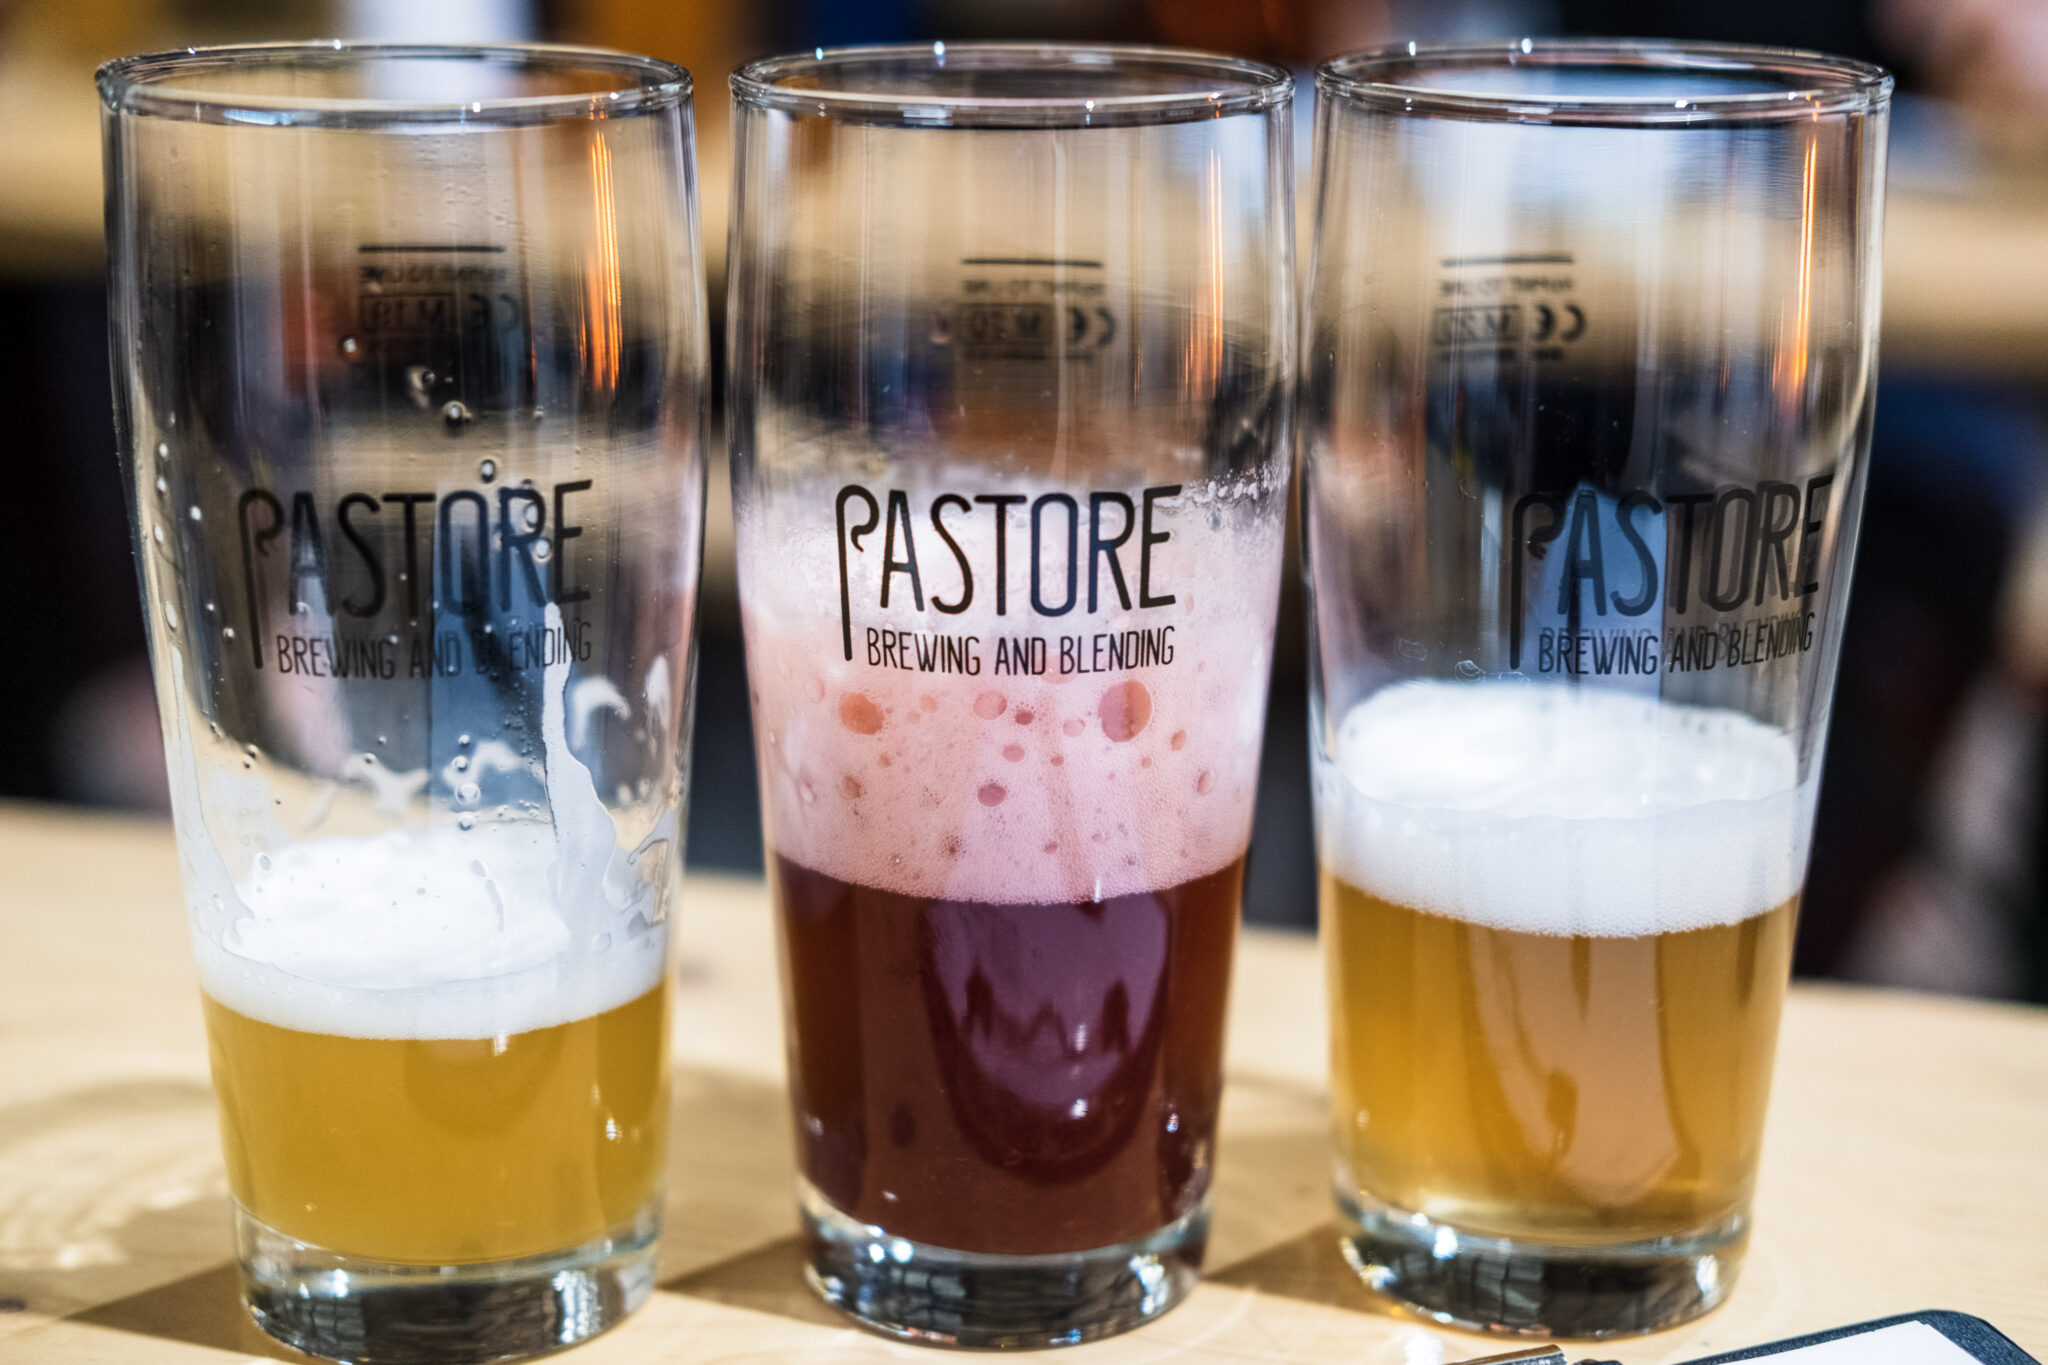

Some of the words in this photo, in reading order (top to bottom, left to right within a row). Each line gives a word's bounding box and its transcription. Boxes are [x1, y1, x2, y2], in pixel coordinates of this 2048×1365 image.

[238, 479, 593, 669] PASTORE
[836, 484, 1182, 661] PASTORE
[1510, 475, 1834, 670] PASTORE
[277, 635, 396, 680] BREWING
[409, 636, 462, 678] AND
[475, 622, 592, 675] BLENDING
[866, 627, 981, 676] BREWING
[994, 637, 1047, 676] AND
[1059, 625, 1175, 674] BLENDING
[1538, 634, 1659, 675] BREWING
[1669, 632, 1718, 673] AND
[1726, 612, 1816, 667] BLENDING
